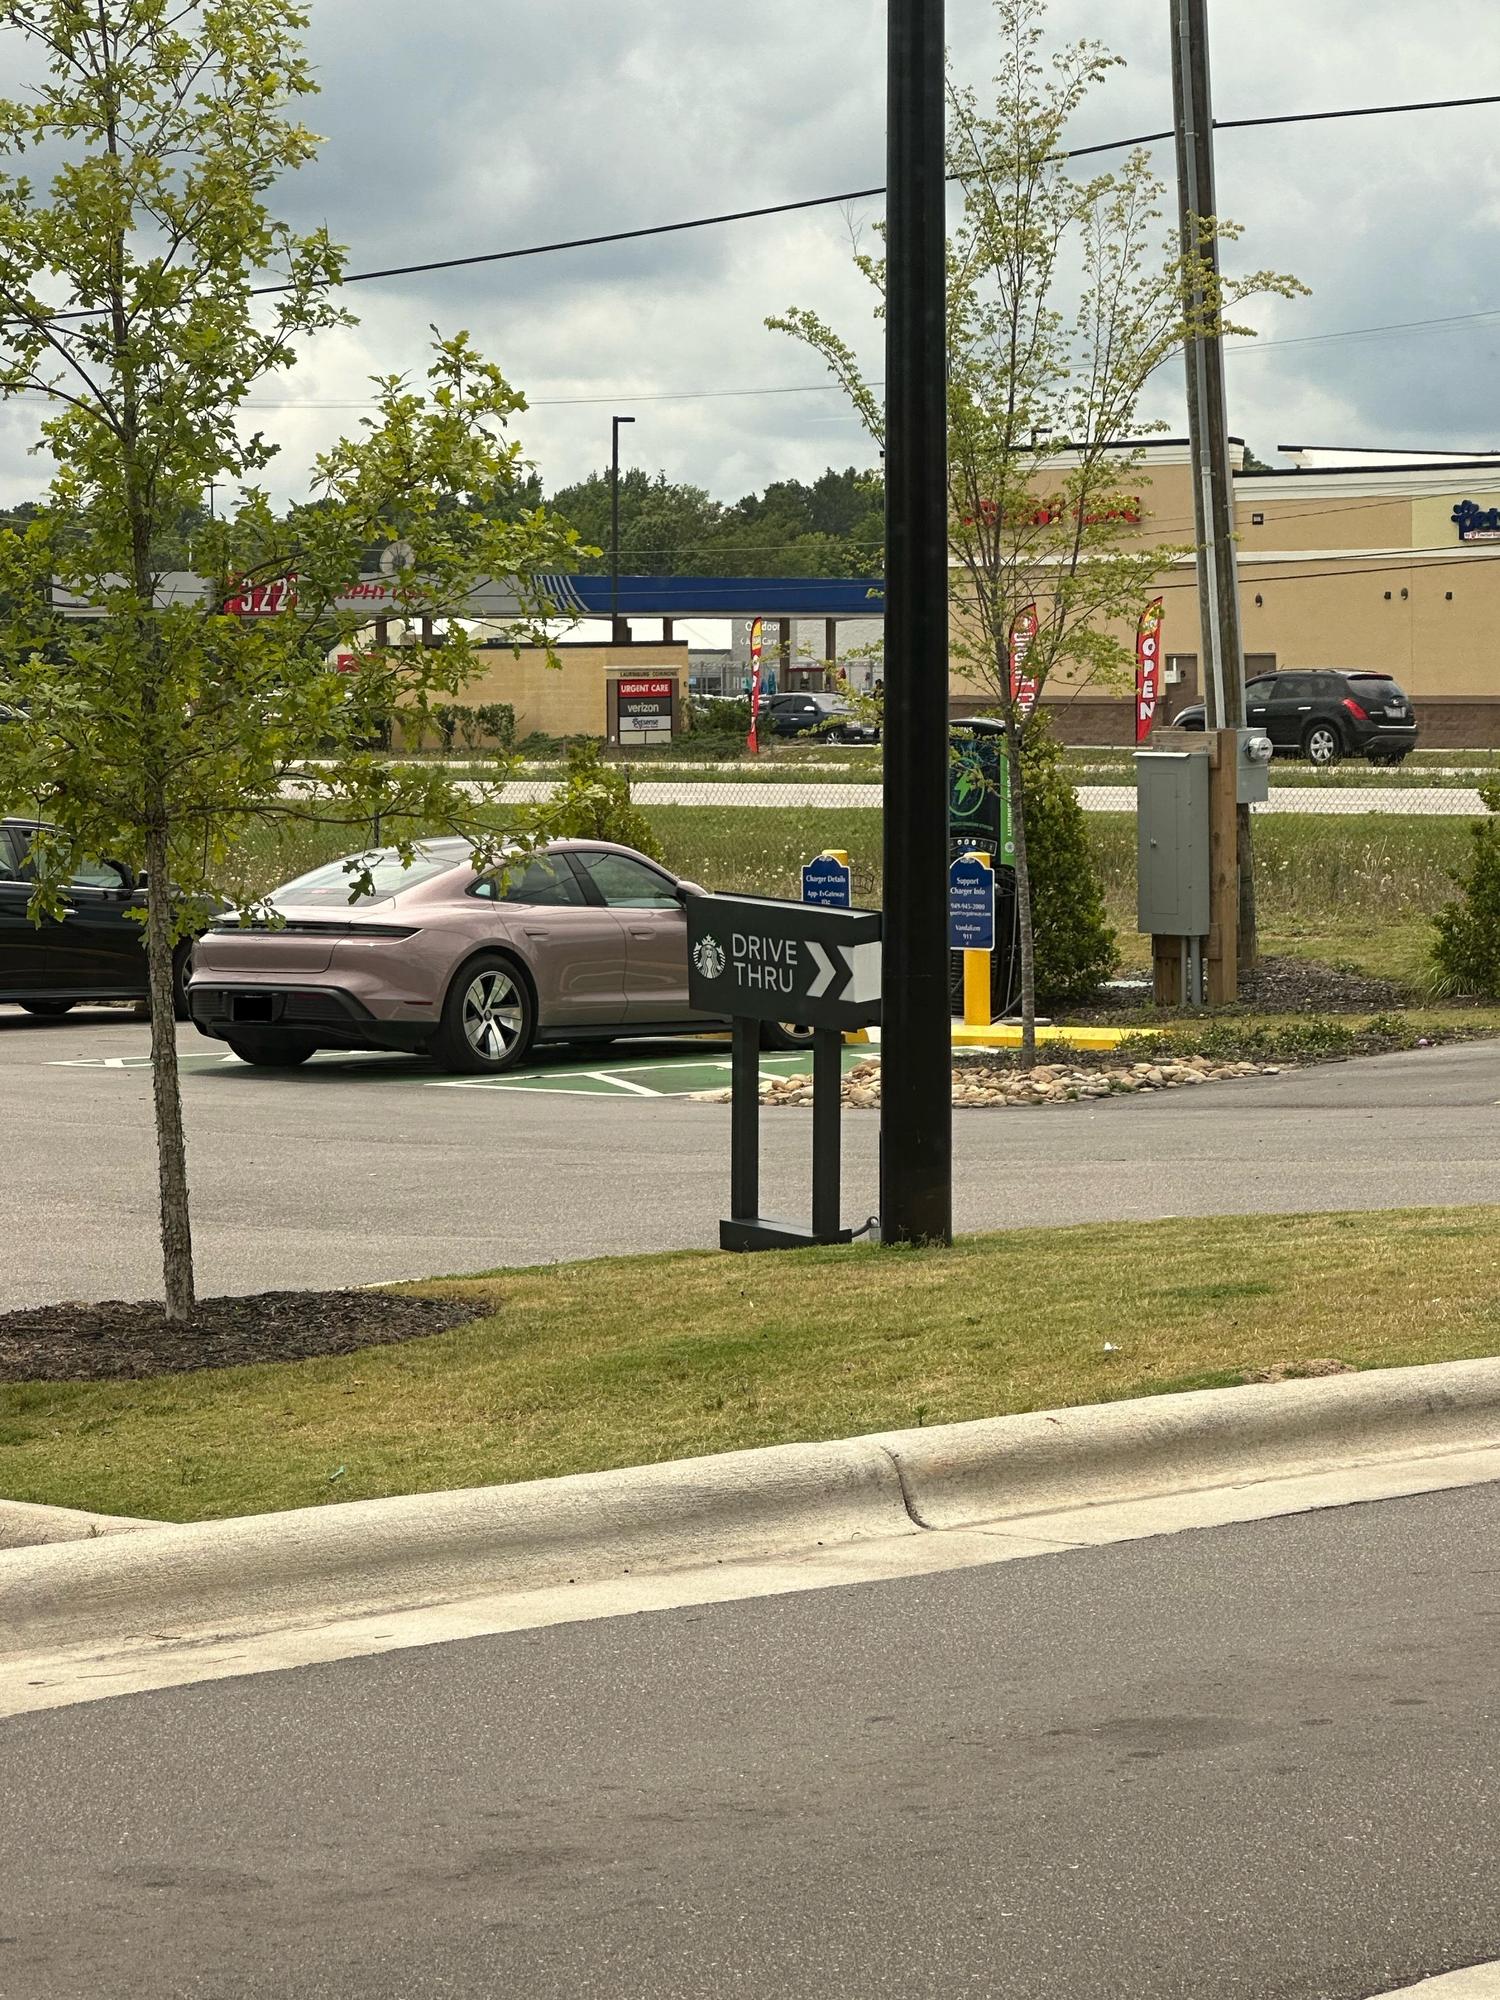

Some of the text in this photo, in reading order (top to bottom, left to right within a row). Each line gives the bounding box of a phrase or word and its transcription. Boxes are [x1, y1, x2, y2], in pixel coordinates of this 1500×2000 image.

[1140, 637, 1156, 721] OPEN
[620, 684, 669, 693] URGENT CARE
[627, 702, 659, 712] verizon
[805, 875, 846, 884] Charger Details
[956, 876, 979, 887] Support
[950, 887, 986, 896] Charger Info
[955, 923, 981, 932] Vandalism
[732, 933, 798, 966] DRIVE
[733, 961, 793, 993] THRU
